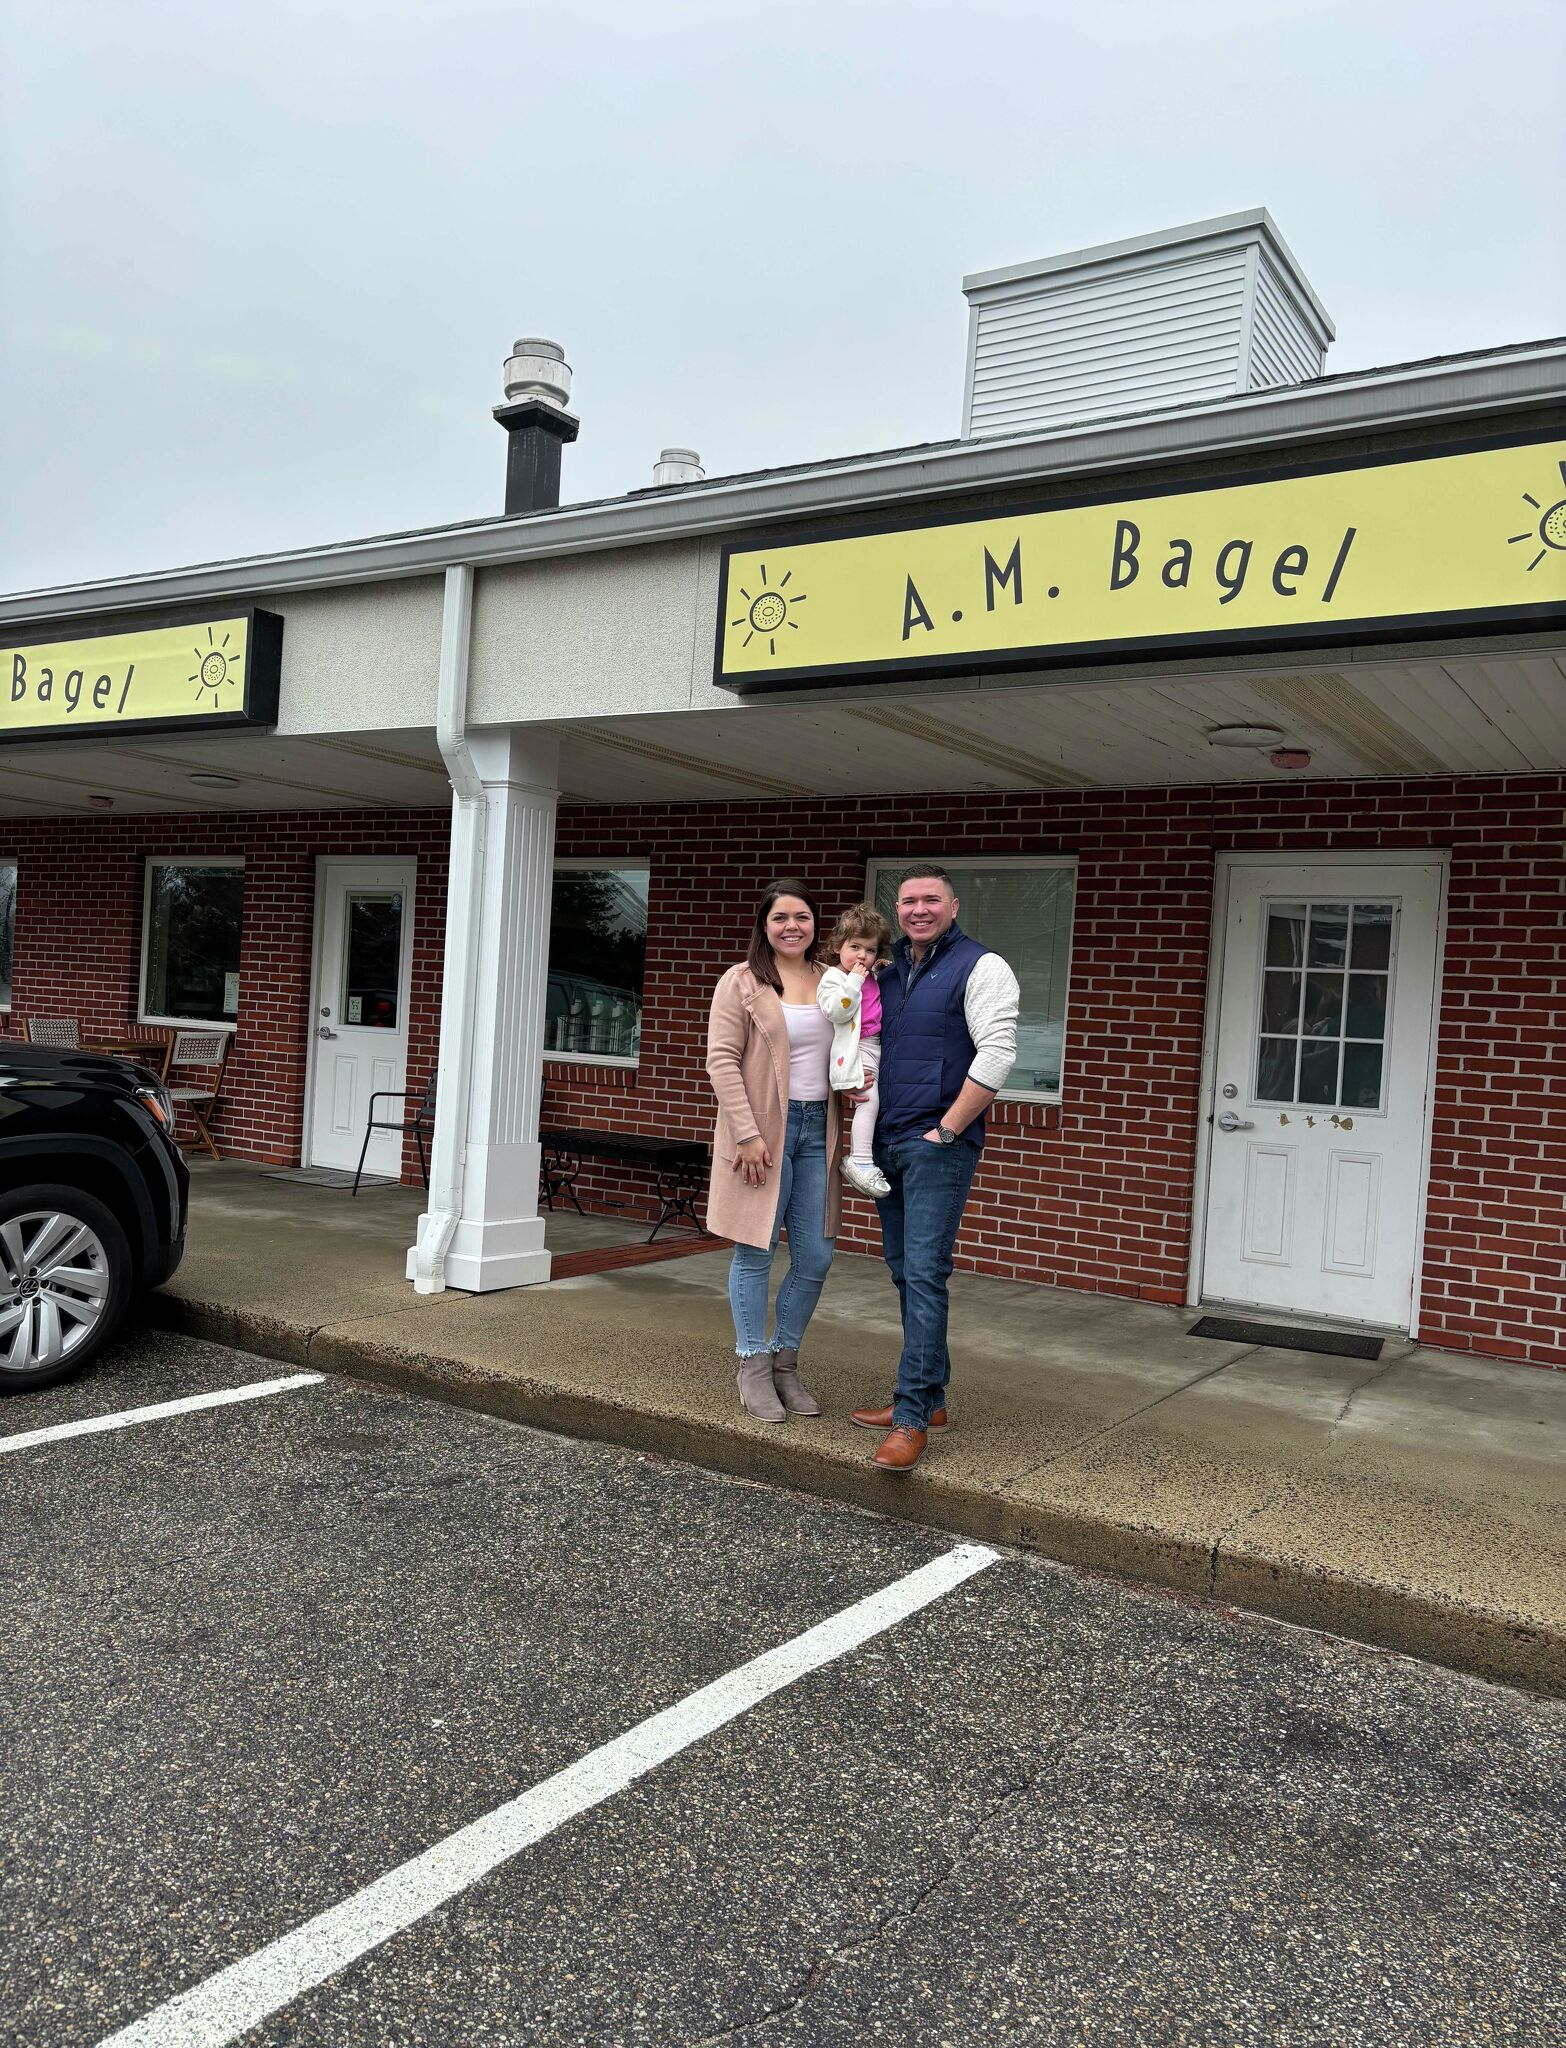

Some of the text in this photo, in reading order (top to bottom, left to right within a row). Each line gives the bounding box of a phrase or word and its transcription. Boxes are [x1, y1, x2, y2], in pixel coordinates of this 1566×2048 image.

[902, 519, 1357, 642] A.M. Bagel
[11, 653, 135, 714] Bagel
